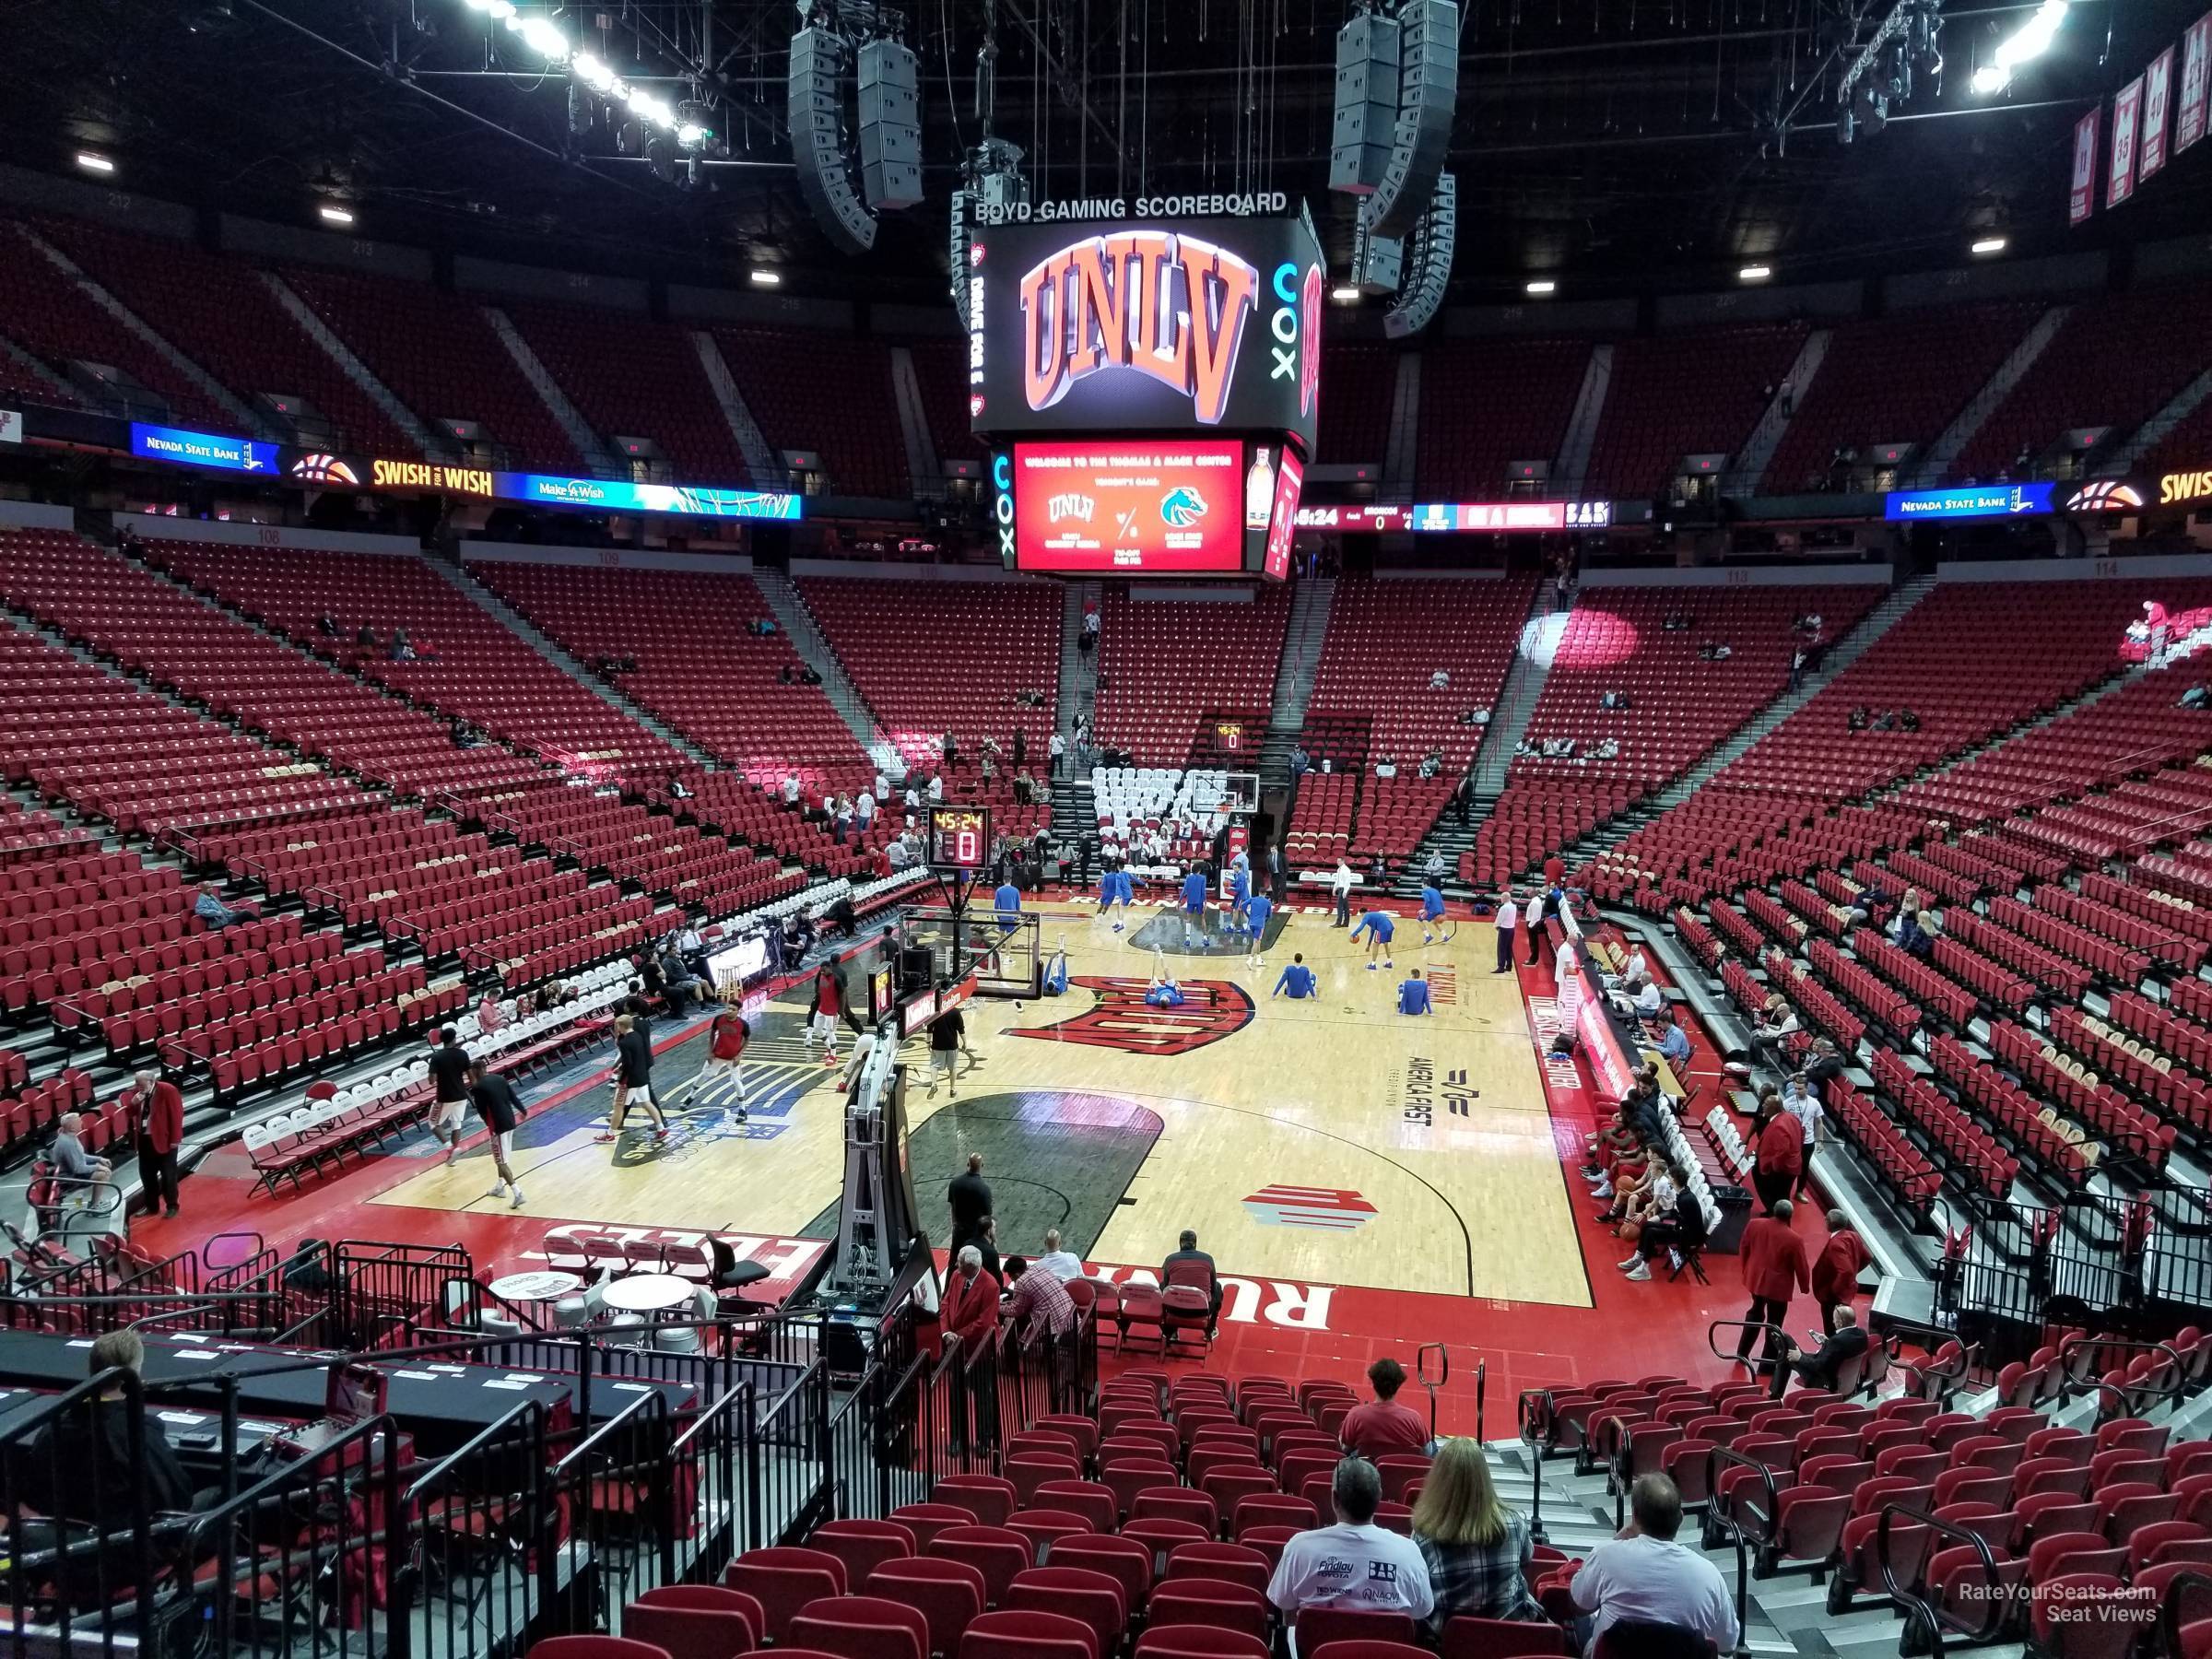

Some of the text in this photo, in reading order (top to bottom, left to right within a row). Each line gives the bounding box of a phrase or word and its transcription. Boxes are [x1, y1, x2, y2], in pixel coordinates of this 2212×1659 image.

[108, 192, 131, 208] 212
[975, 192, 1287, 221] BOYD GAMING SCOREBOARD
[1020, 230, 1259, 425] UNLV
[1271, 263, 1298, 382] COX
[147, 437, 240, 461] NEVADA STATE BANK
[373, 460, 431, 486] SWISH
[444, 467, 492, 496] WISH
[994, 456, 1015, 555] COX
[1048, 493, 1095, 523] UNLV
[1901, 497, 2006, 512] NEVADA STATE BANK
[1375, 516, 1384, 529] 0
[258, 528, 279, 545] 108
[599, 552, 619, 565] 109
[1725, 569, 1748, 583] 113
[2096, 561, 2118, 576] 114
[1218, 726, 1240, 735] 45:24
[1229, 735, 1237, 748] 0
[935, 813, 981, 830] 45:24
[959, 831, 975, 861] 0
[1544, 1057, 1583, 1090] CENTER
[1404, 1056, 1433, 1126] AMERICA FIRST
[1318, 1560, 1354, 1573] Findlay
[1369, 1560, 1396, 1582] BAR
